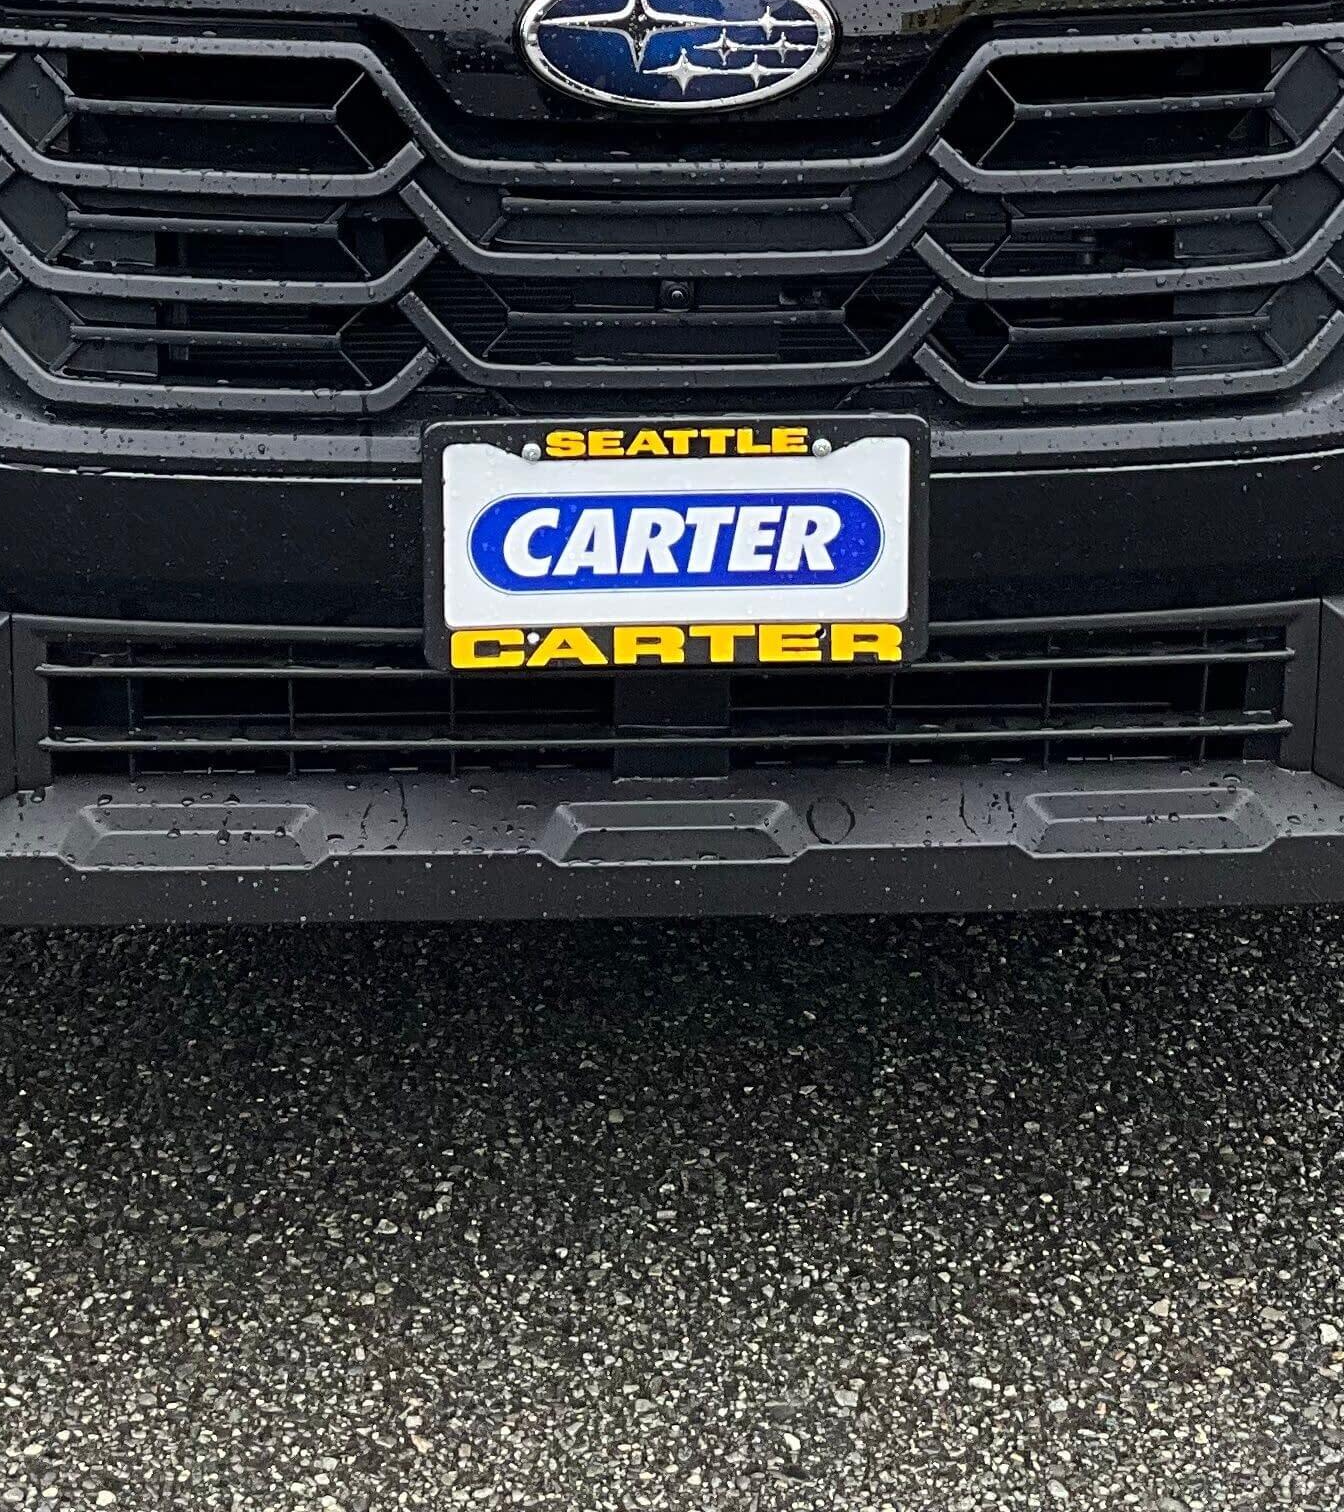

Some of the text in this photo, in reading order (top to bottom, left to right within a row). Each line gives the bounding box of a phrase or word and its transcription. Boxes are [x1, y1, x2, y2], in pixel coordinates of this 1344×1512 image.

[545, 427, 808, 458] SEATTLE
[503, 505, 841, 577] CARTER
[450, 623, 903, 668] CARTER
